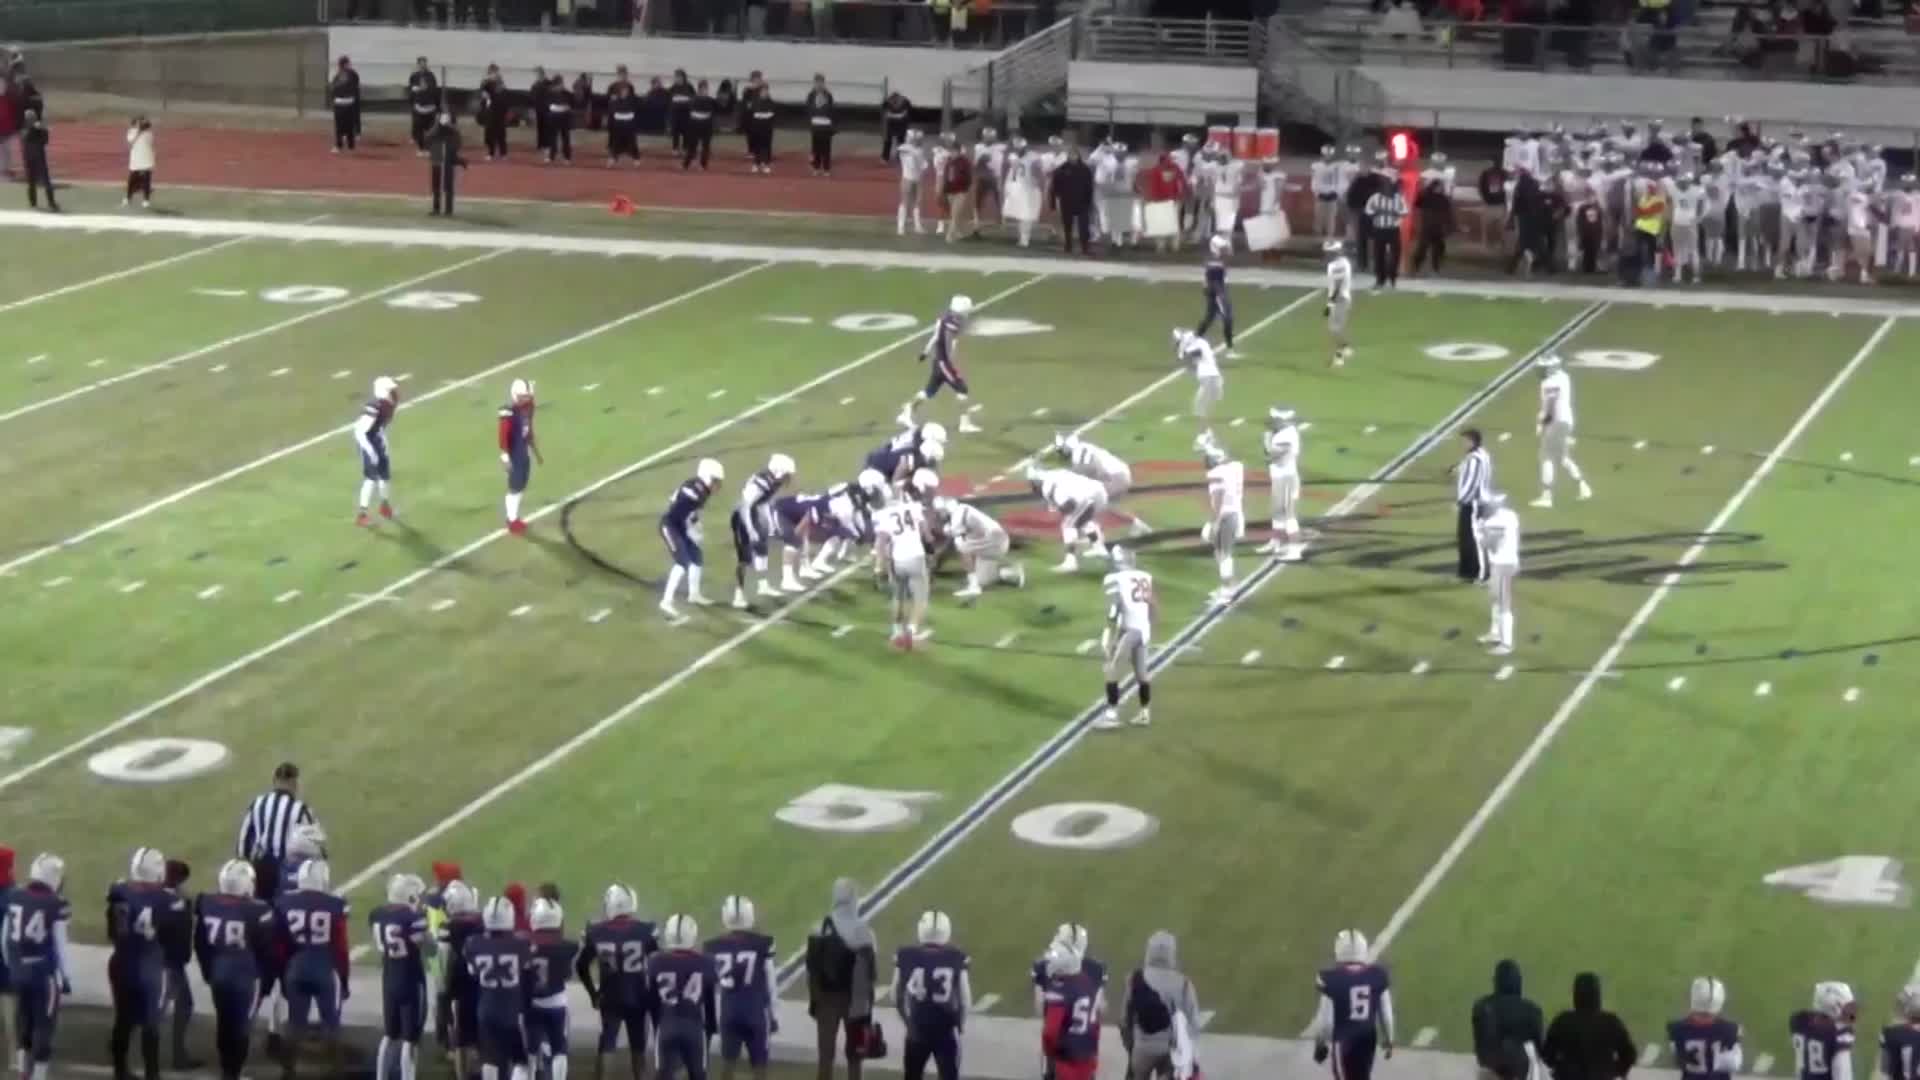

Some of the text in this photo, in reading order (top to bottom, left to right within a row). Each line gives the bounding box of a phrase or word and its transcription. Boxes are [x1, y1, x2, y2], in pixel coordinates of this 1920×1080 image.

[889, 509, 916, 536] 34
[87, 737, 228, 782] 0
[1010, 801, 1158, 849] 0
[286, 908, 331, 944] 29
[372, 922, 408, 958] 15
[474, 953, 519, 988] 23
[714, 950, 757, 988] 27
[906, 966, 953, 1003] 43
[656, 971, 703, 1004] 24
[1349, 985, 1370, 1020] 6
